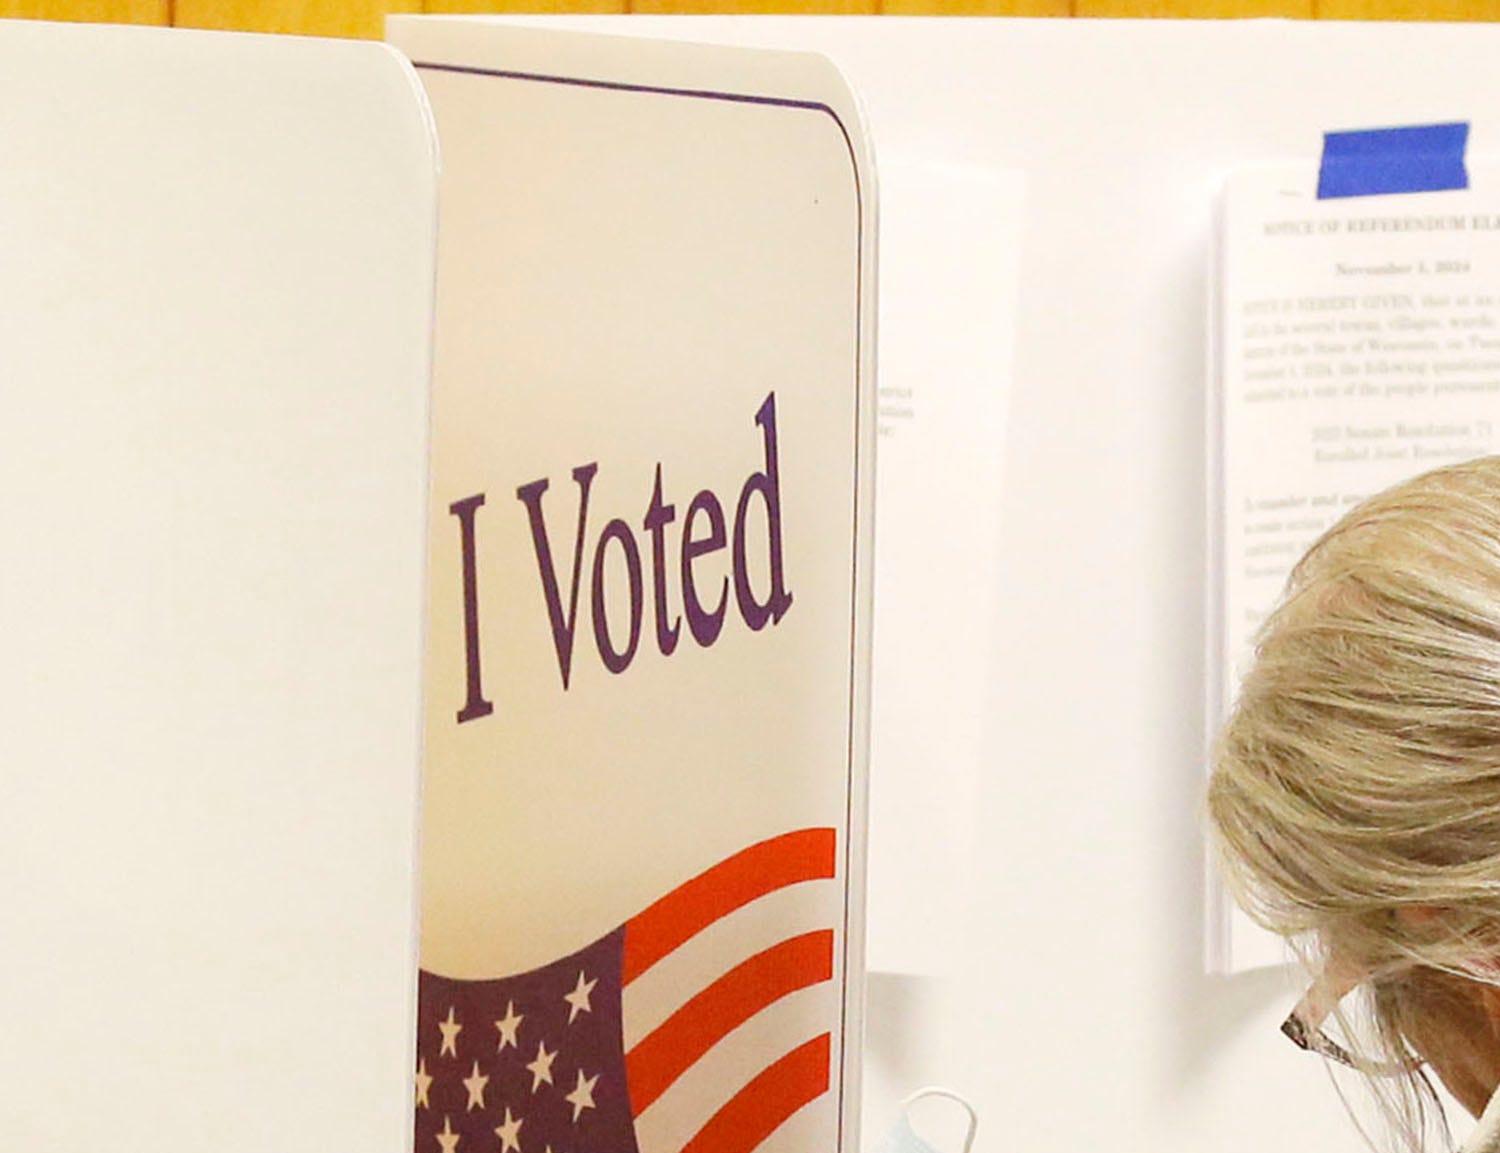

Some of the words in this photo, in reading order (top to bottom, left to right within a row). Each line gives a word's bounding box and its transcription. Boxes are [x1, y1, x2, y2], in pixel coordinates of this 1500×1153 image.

[1318, 219, 1340, 235] OF
[1346, 216, 1466, 233] REFERENDUM
[1335, 262, 1412, 276] November
[448, 492, 494, 724] I
[515, 390, 794, 692] Voted
